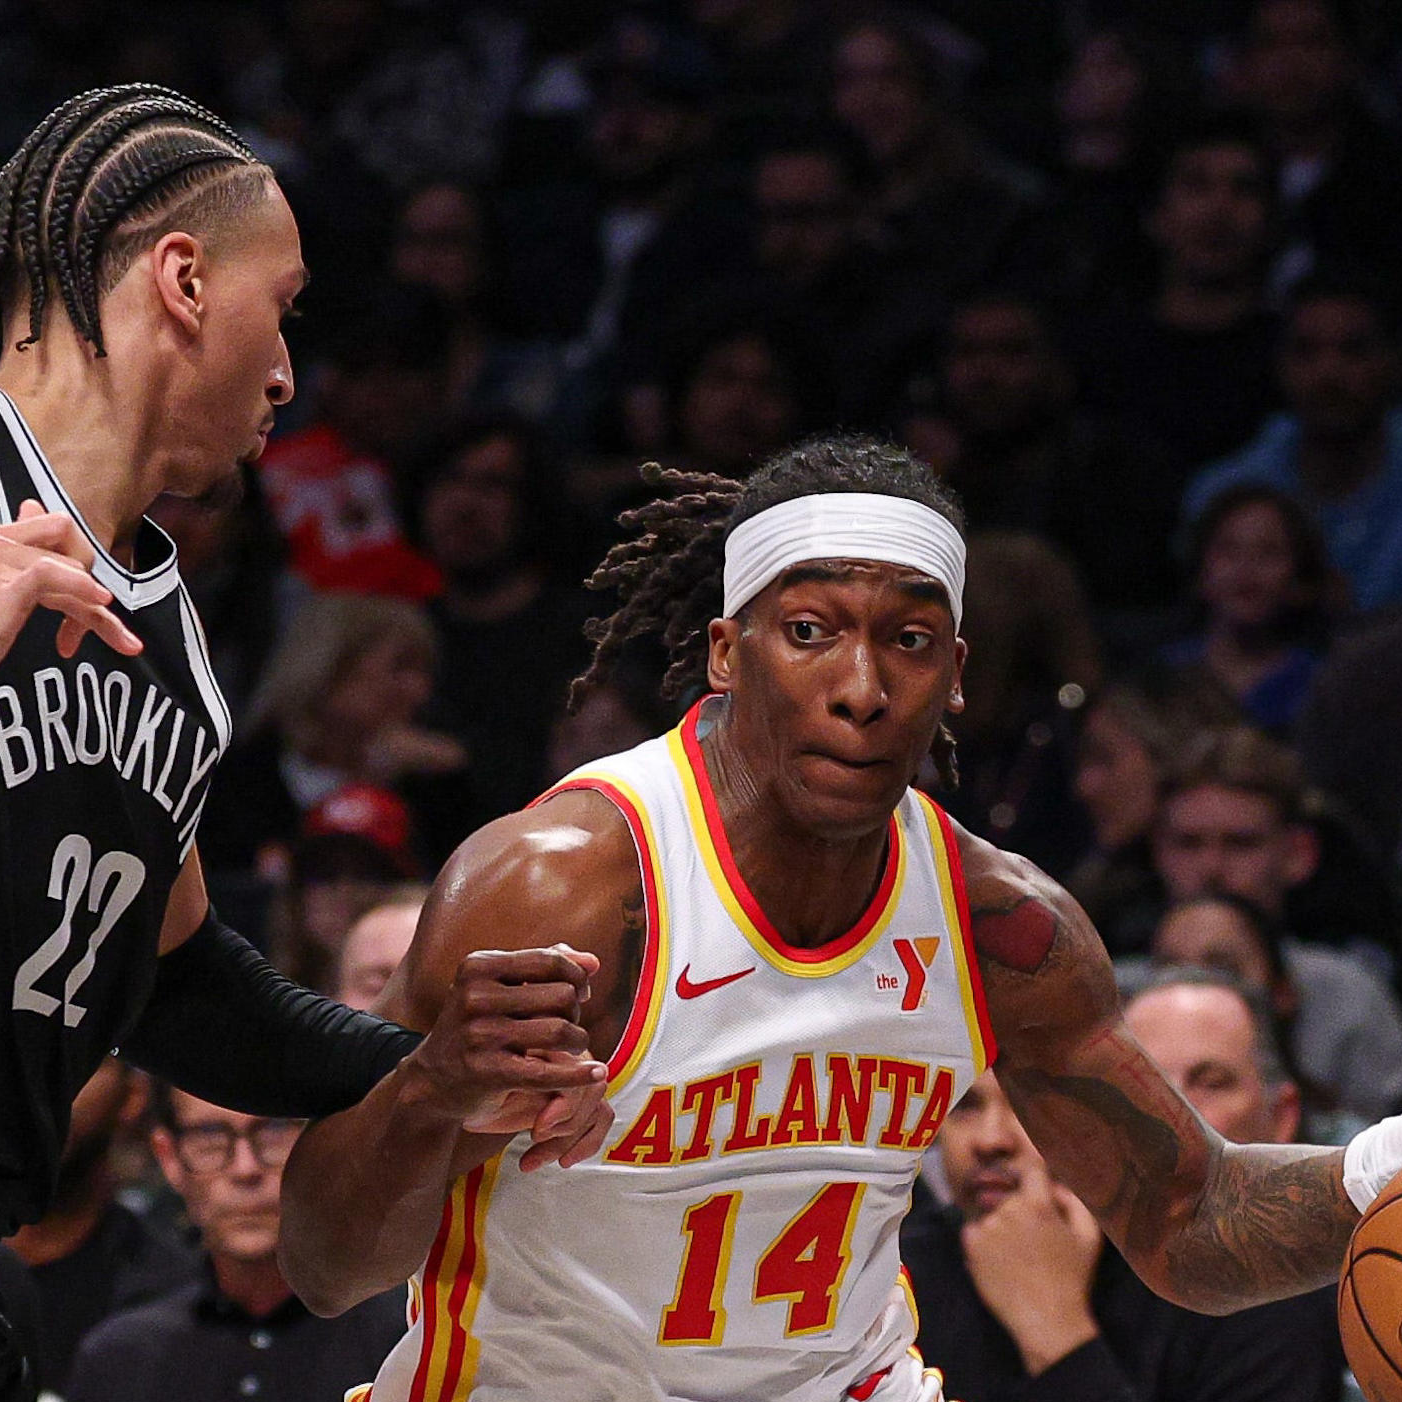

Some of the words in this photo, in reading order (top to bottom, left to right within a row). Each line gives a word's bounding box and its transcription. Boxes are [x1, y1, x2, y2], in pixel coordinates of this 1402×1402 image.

[12, 833, 146, 1028] 22
[876, 973, 899, 990] the
[602, 1052, 955, 1167] ATLANTA
[657, 1181, 868, 1347] 14
